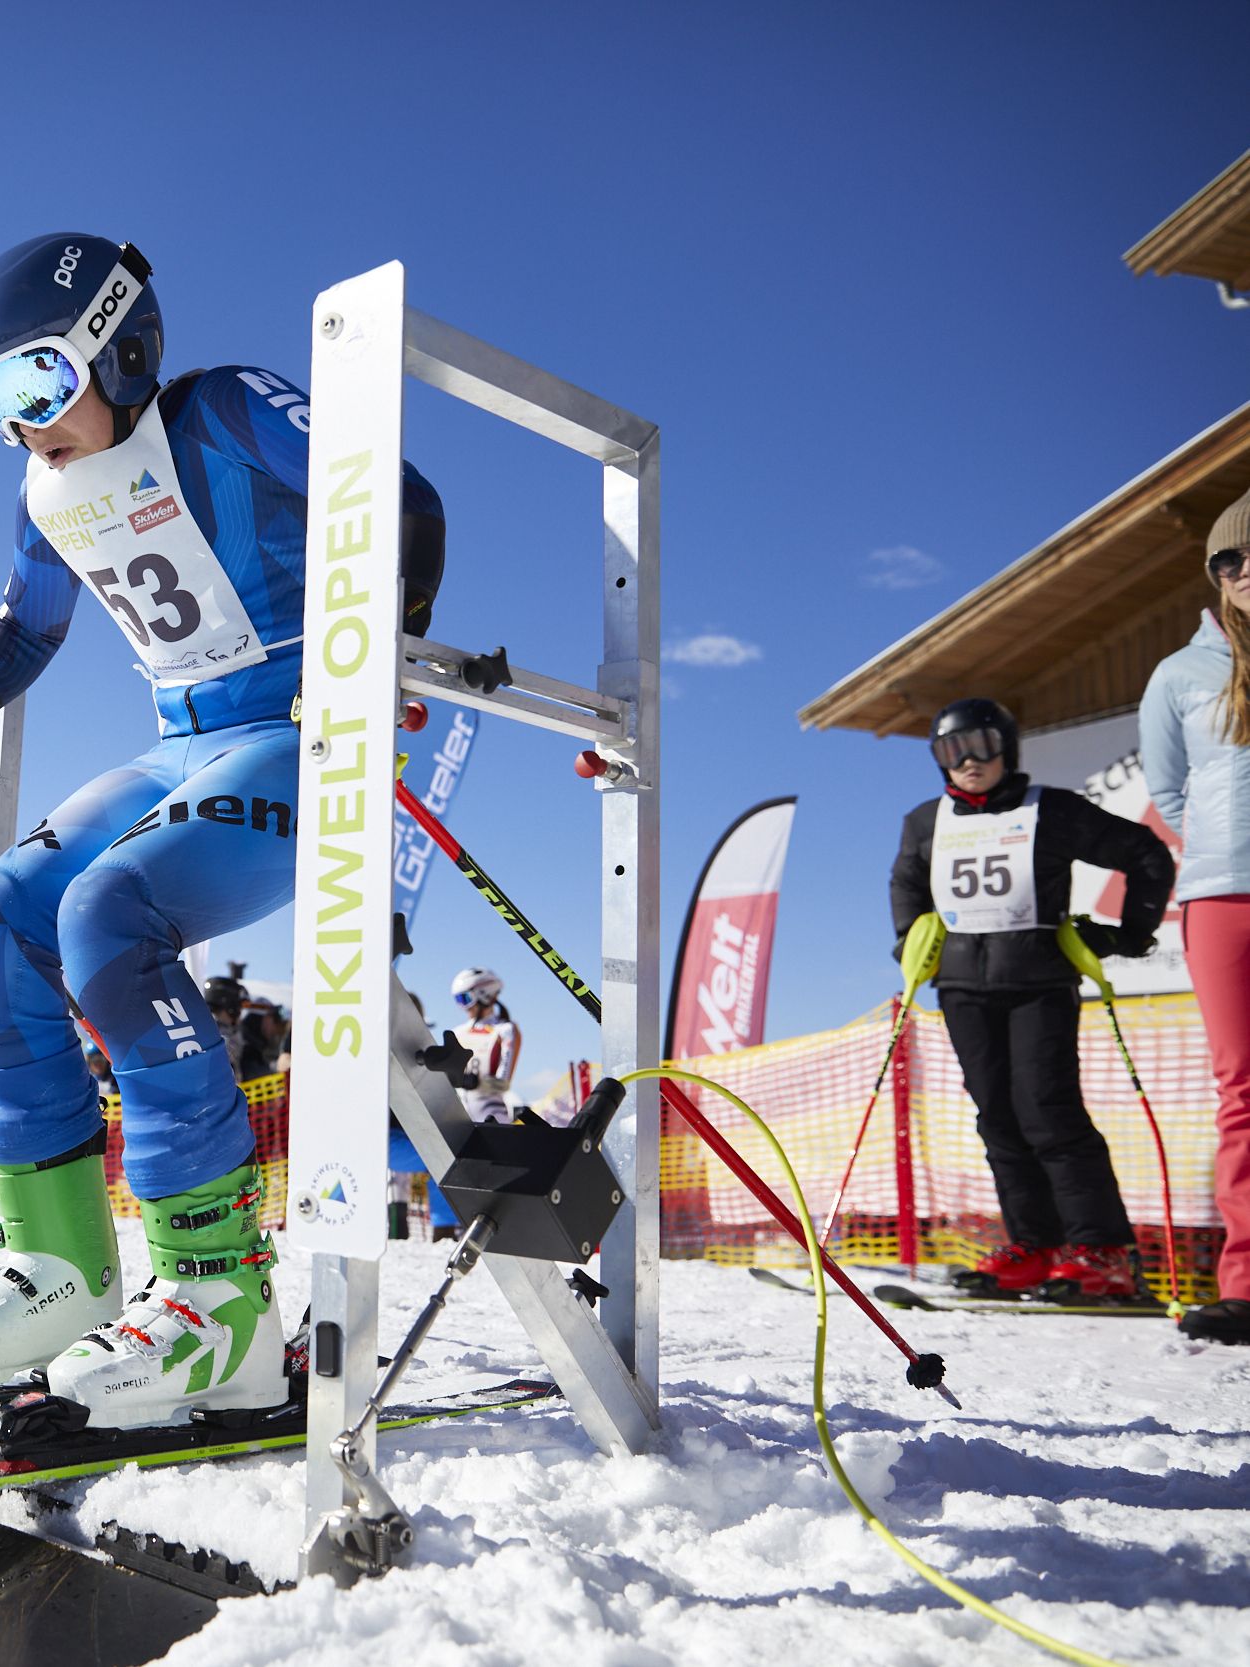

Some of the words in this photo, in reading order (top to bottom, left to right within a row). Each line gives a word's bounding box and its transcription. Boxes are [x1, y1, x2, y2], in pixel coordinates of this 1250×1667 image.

[36, 493, 117, 533] SKIWELT
[98, 524, 118, 536] powered
[134, 504, 175, 527] SkiWelt
[50, 528, 96, 553] OPEN
[322, 449, 373, 678] OPEN
[86, 553, 201, 647] 53
[1086, 748, 1143, 806] SCH
[313, 708, 367, 1059] SKIWELT
[951, 854, 1012, 899] 55
[528, 932, 590, 997] LEKI
[311, 1162, 340, 1190] SKIWELT
[341, 1166, 358, 1193] OPEN
